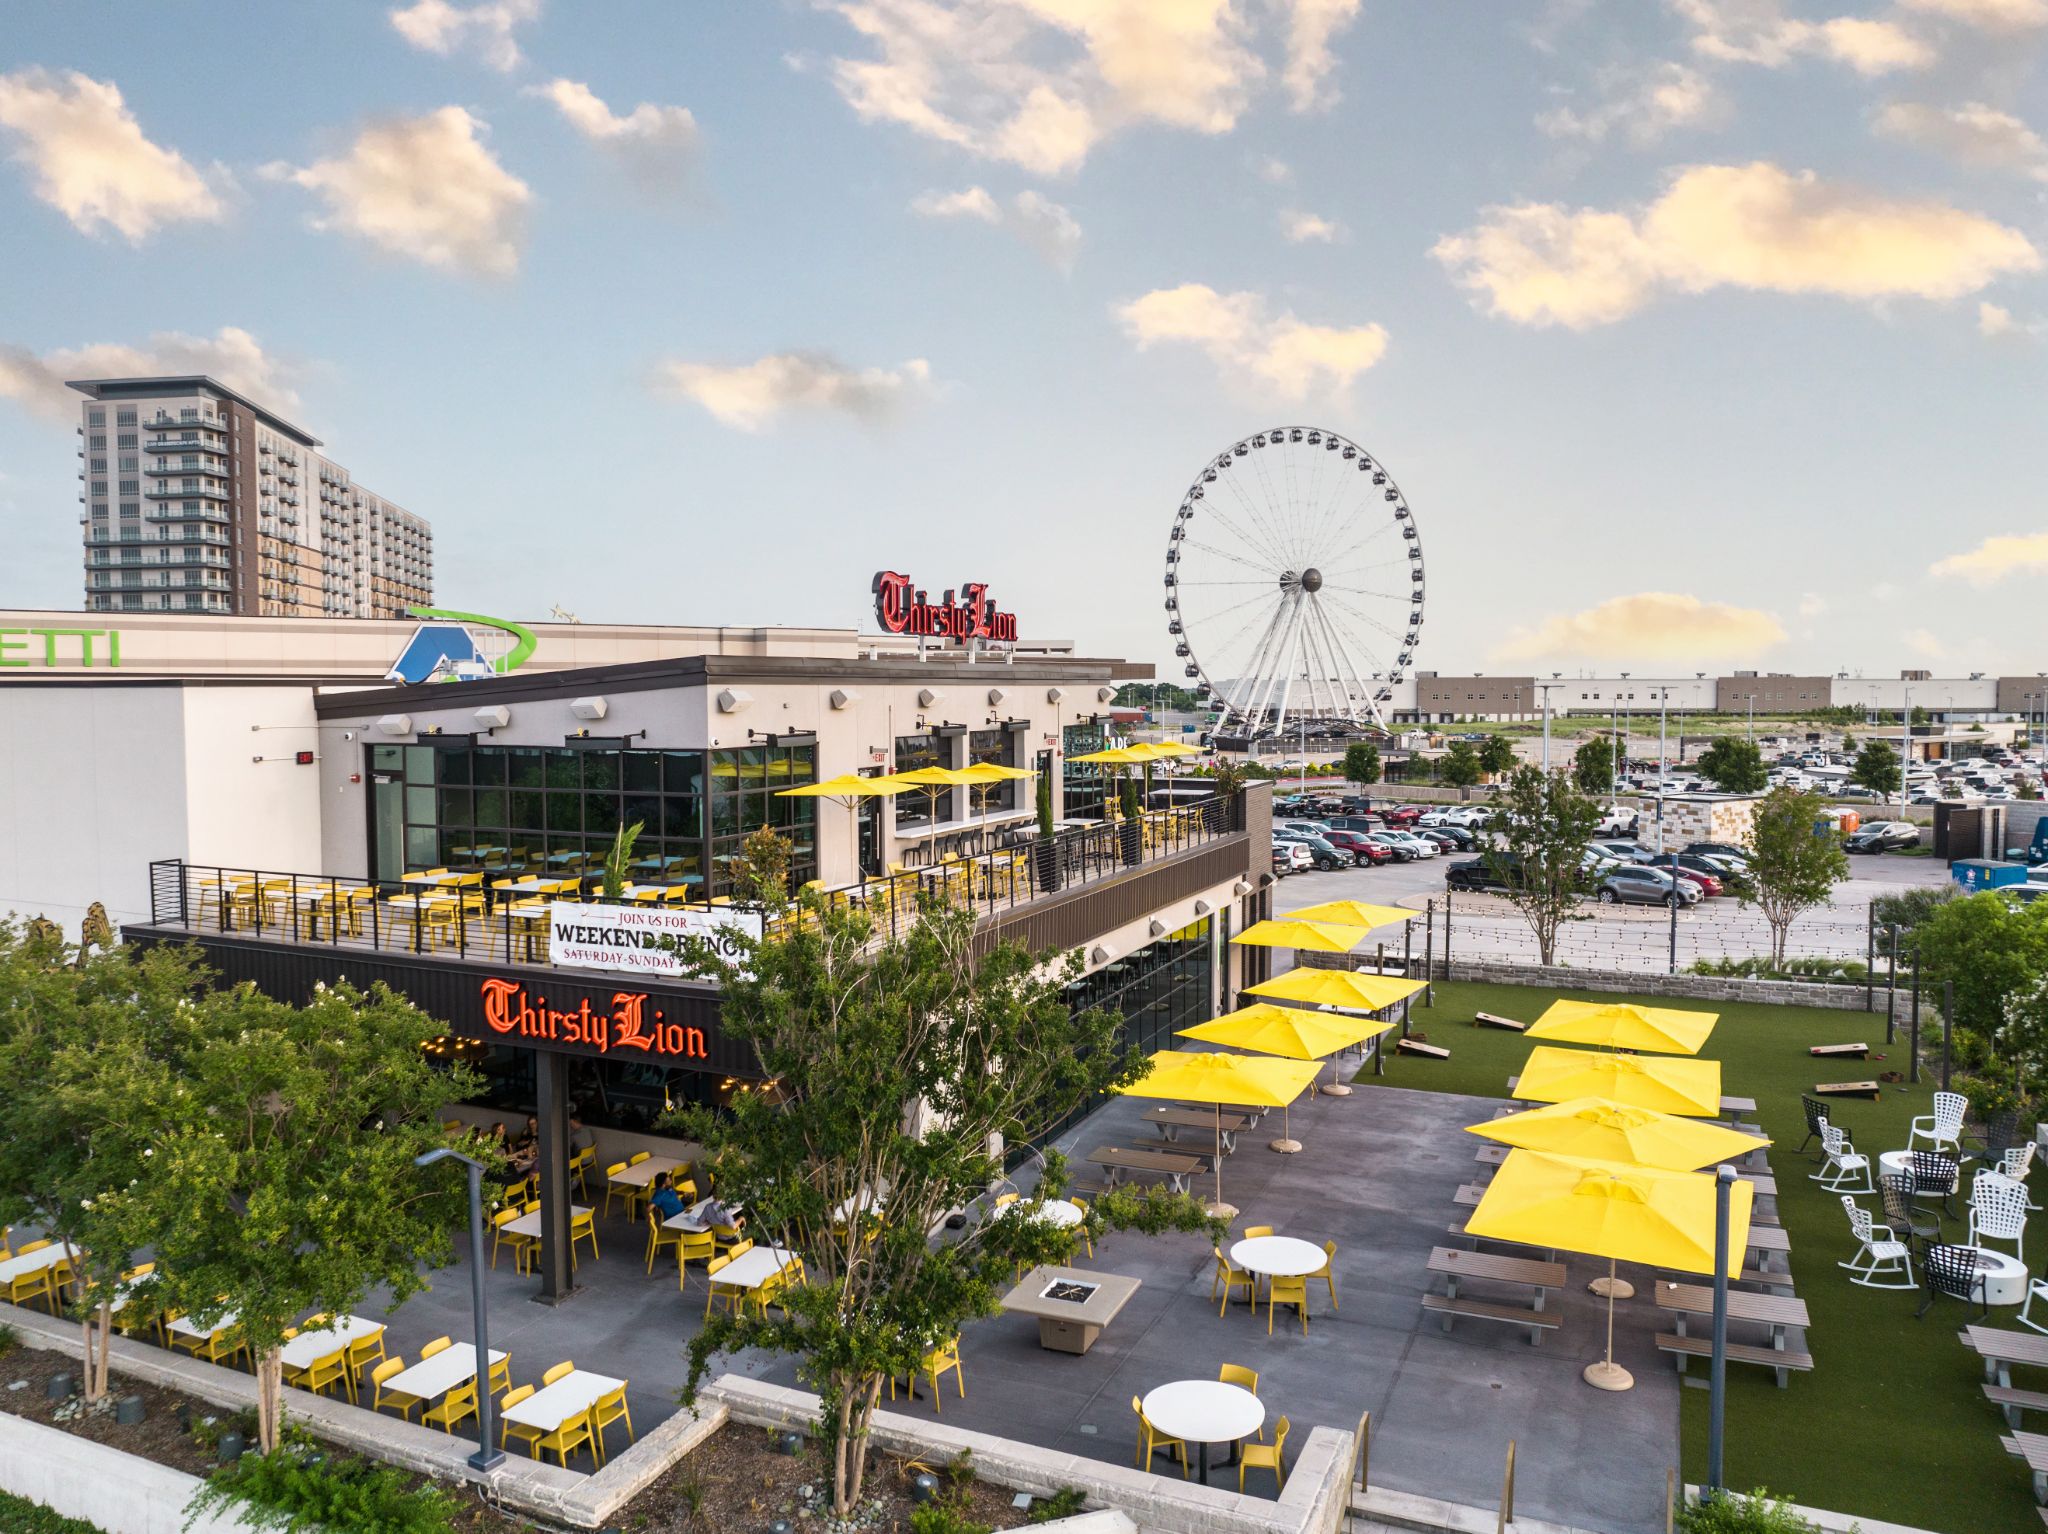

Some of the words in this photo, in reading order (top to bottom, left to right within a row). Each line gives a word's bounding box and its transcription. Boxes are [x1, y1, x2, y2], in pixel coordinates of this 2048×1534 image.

[874, 570, 967, 646] Thirsty
[964, 583, 1017, 641] Lion
[874, 753, 886, 763] EXIT
[618, 912, 644, 926] JOIN
[649, 915, 662, 927] US
[665, 916, 687, 929] FOR
[555, 923, 656, 950] WEEKEND
[564, 949, 675, 969] SATURDAY-SUNDAY
[481, 978, 608, 1054] Thirsty
[611, 992, 709, 1059] Lion
